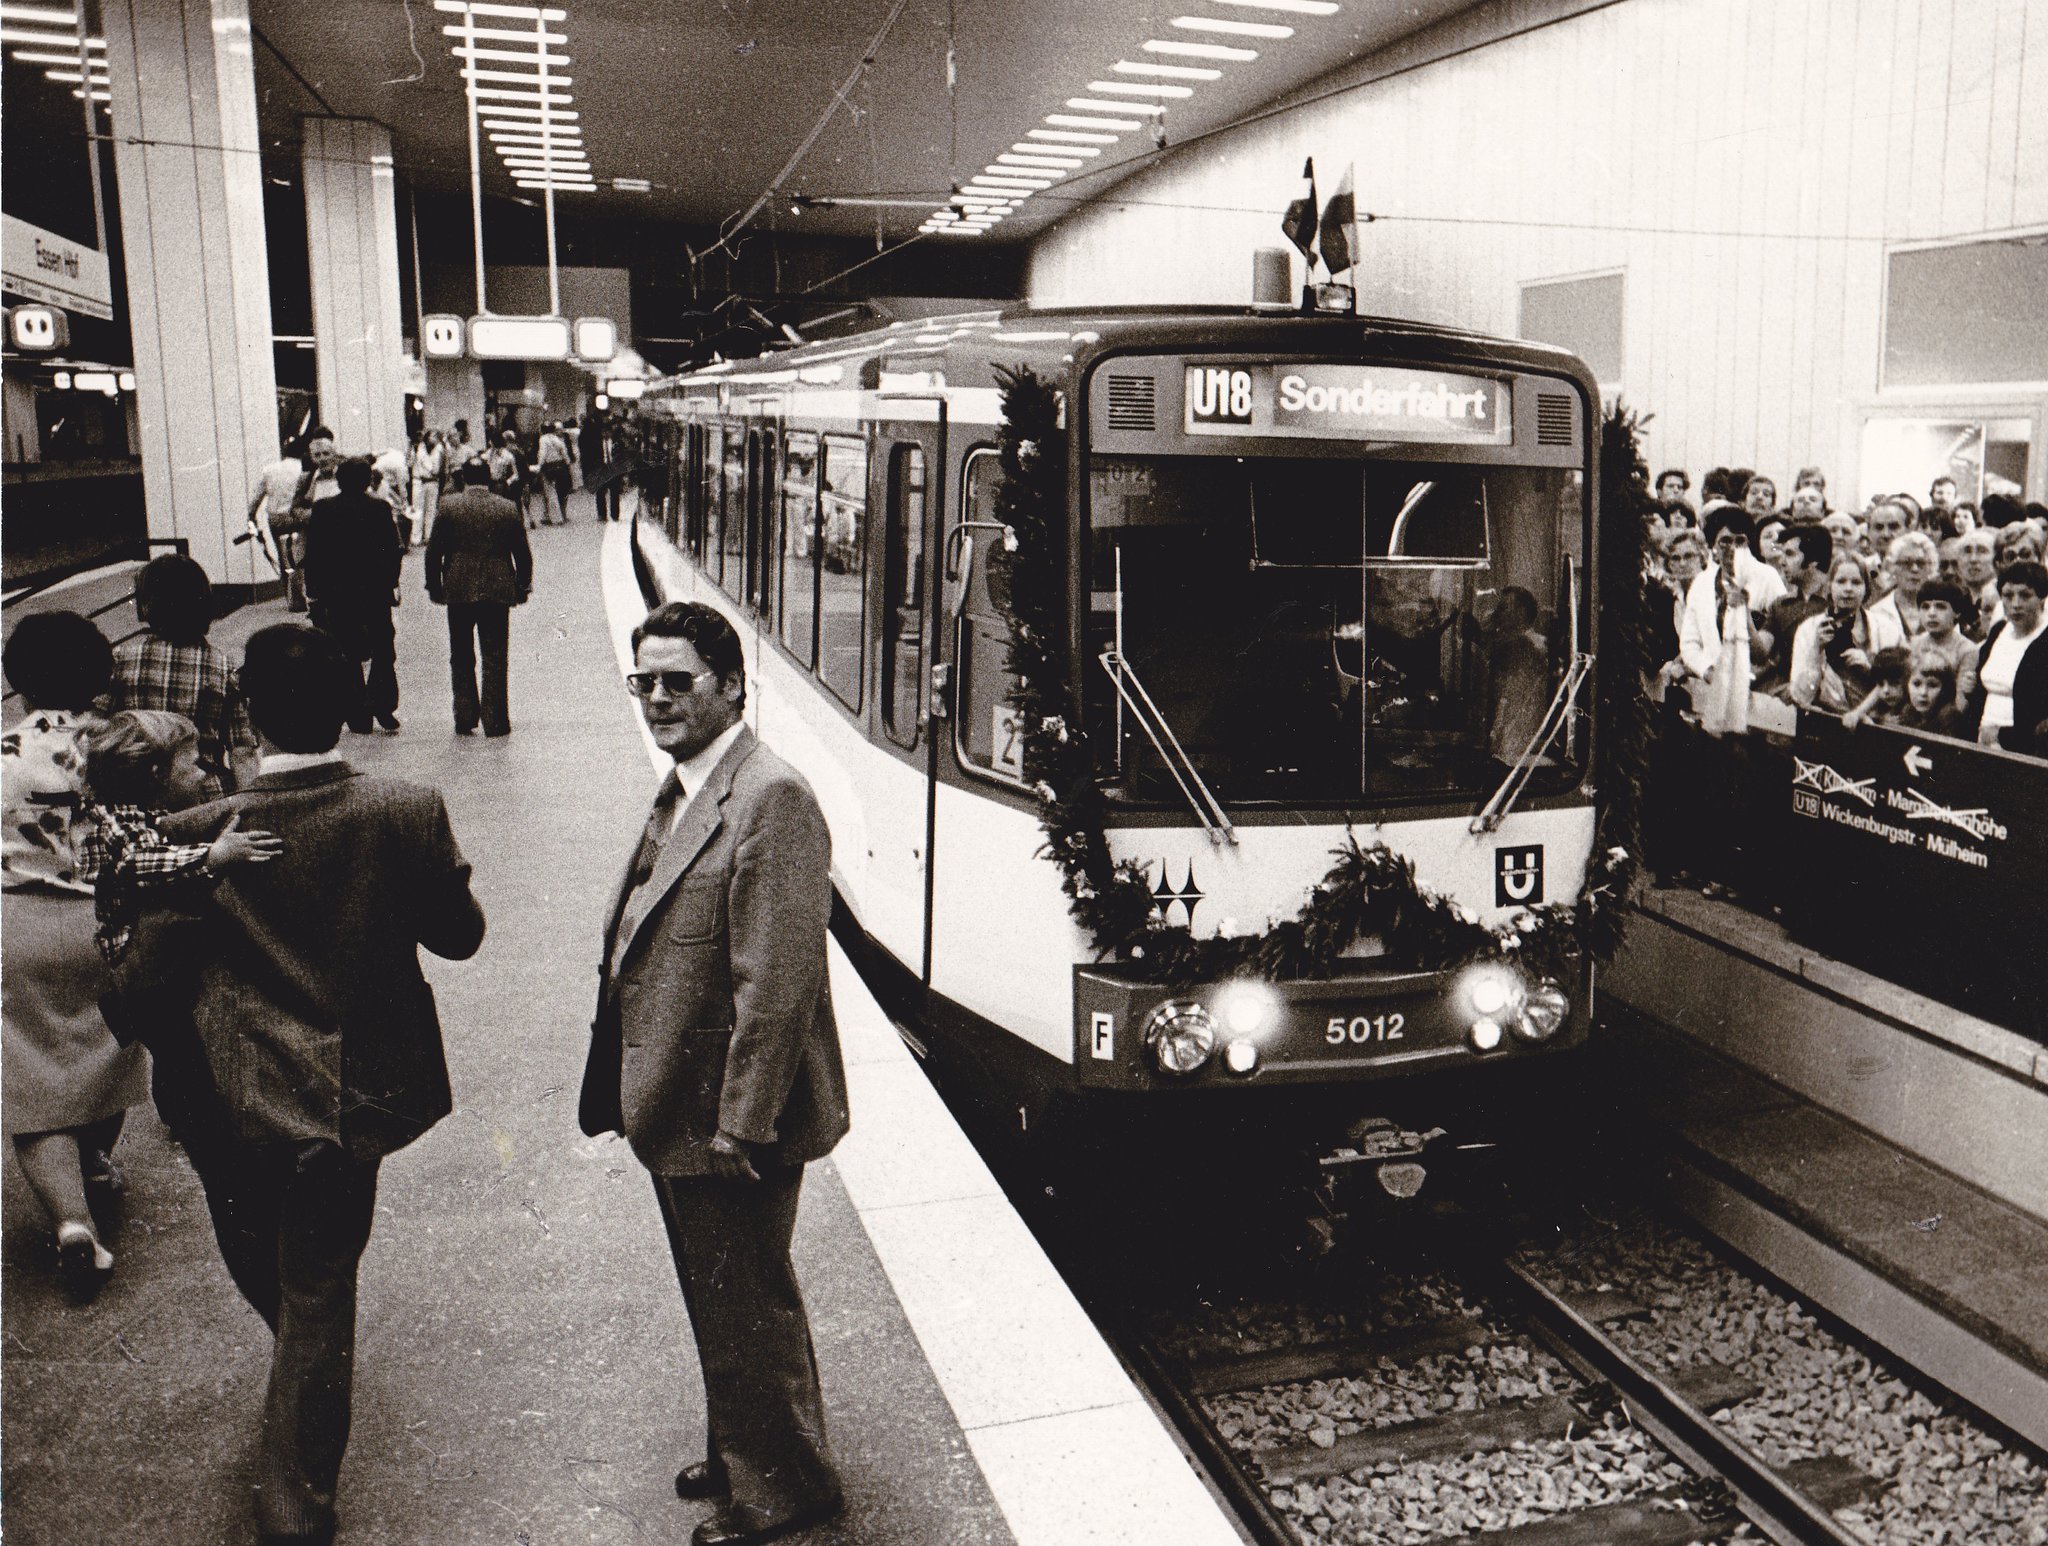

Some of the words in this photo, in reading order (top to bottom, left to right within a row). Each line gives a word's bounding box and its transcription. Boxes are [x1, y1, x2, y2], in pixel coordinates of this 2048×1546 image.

[1193, 369, 1251, 416] U18
[1280, 375, 1487, 419] Sonderfahrt
[1823, 768, 1877, 803] Klinum
[1887, 789, 2007, 840] Margarthnhöhe
[1795, 793, 1818, 814] U18
[1822, 801, 1917, 845] Wickenburgstr.
[1926, 833, 1988, 868] Mülheim
[1096, 1020, 1108, 1051] F
[1325, 1013, 1405, 1044] 5012
